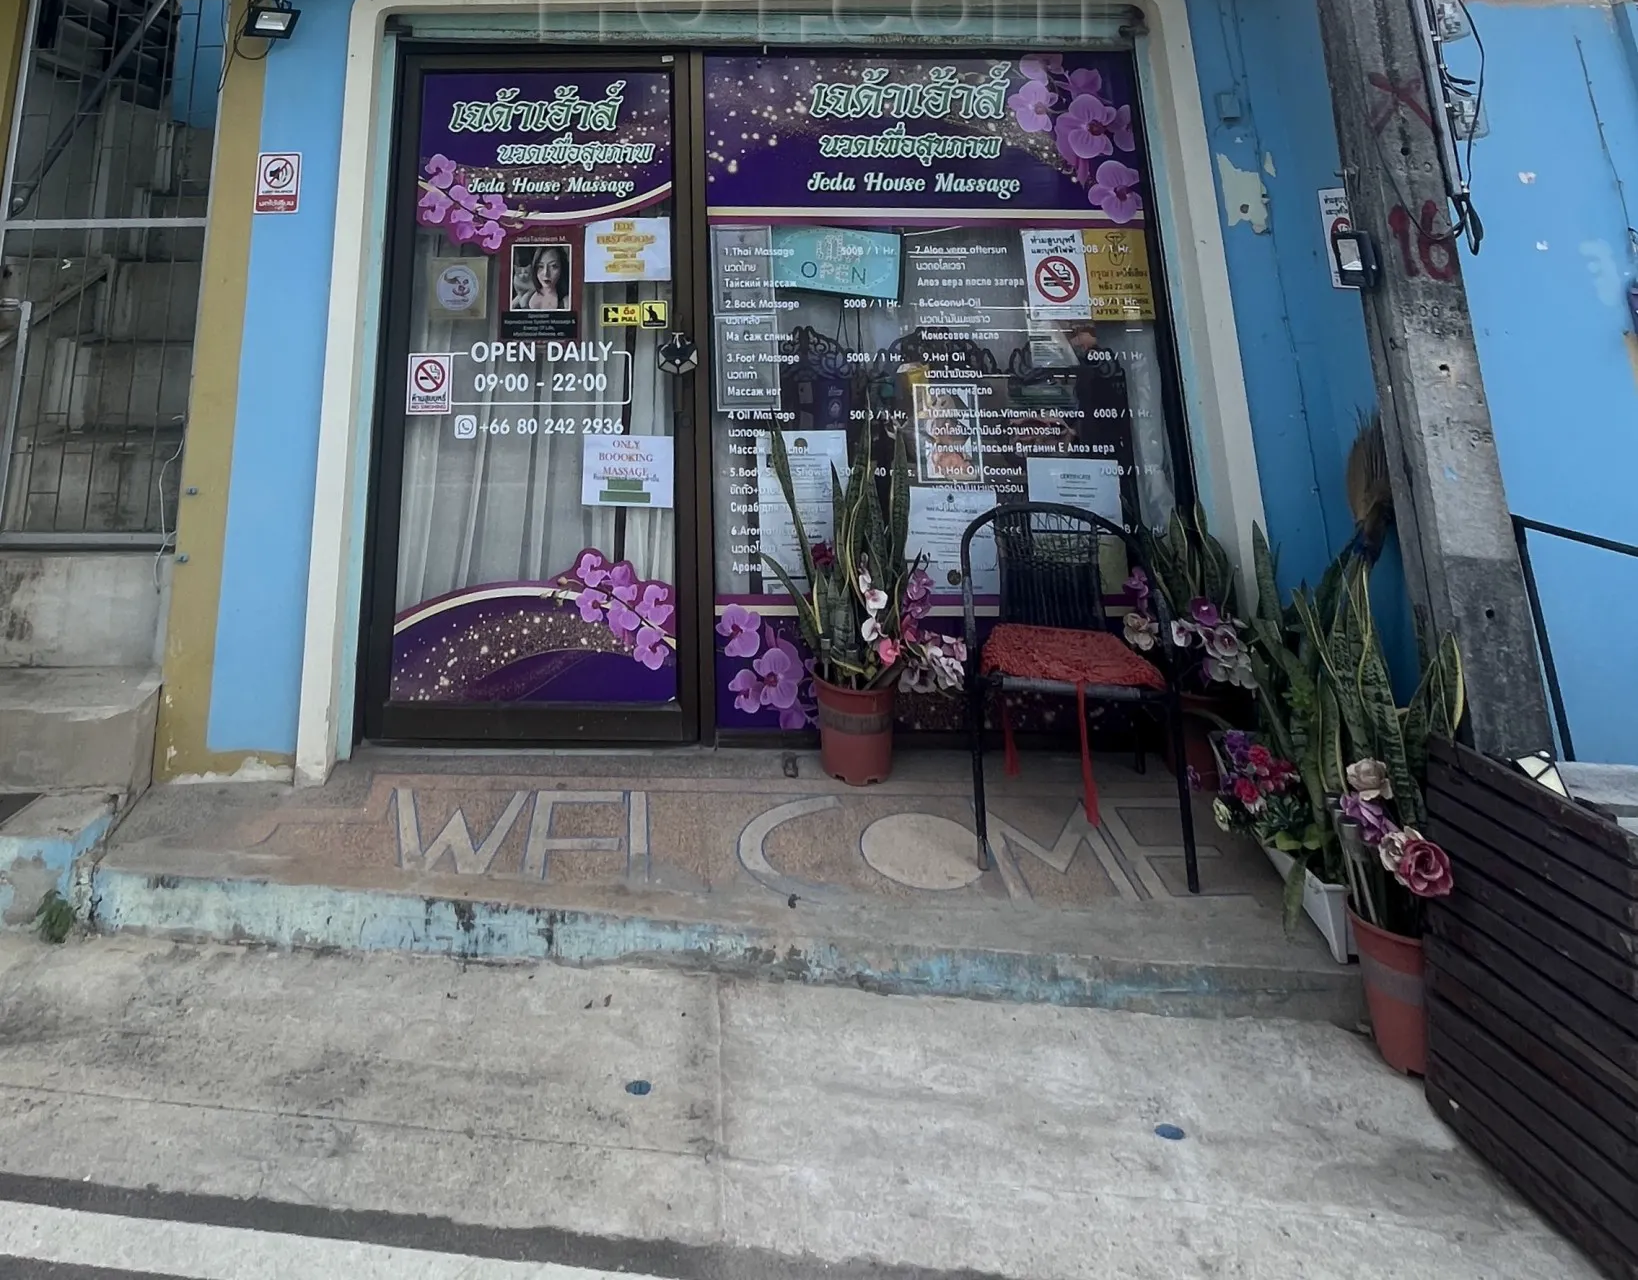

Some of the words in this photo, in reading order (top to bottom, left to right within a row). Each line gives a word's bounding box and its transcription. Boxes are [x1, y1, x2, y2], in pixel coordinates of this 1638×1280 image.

[818, 122, 1003, 167] นวดเพื่อสุขภาพ
[496, 133, 656, 171] นวดเพื่อสุขภาพ
[467, 176, 505, 194] Jeda
[512, 176, 561, 194] House
[567, 176, 634, 197] Massage
[807, 172, 856, 194] Jeda
[863, 172, 926, 193] House
[934, 172, 1020, 199] Massage
[1387, 199, 1458, 282] 16
[754, 247, 795, 258] Massage
[724, 261, 757, 272] นวดไทย
[801, 261, 866, 286] OPEN
[725, 277, 761, 288] Тайский
[763, 279, 798, 288] массаж
[965, 278, 992, 287] после
[994, 278, 1025, 288] загара
[759, 299, 800, 310] Massage
[886, 299, 902, 308] Hr.
[921, 330, 970, 340] Кокосовое
[972, 331, 1000, 340] масло
[471, 341, 536, 363] OPEN
[547, 341, 613, 363] DAILY
[922, 352, 949, 363] 9.Hot
[952, 351, 966, 362] Oil
[758, 353, 800, 365] Massage
[890, 352, 905, 362] Hr.
[727, 386, 764, 397] Массаж
[1000, 408, 1038, 418] Vitamin
[1049, 408, 1085, 418] Alovera
[479, 418, 510, 435] +66
[516, 418, 538, 435] 80
[544, 418, 576, 435] 242
[581, 418, 624, 435] 2936
[612, 440, 641, 450] ONLY
[729, 444, 765, 454] Массаж
[981, 443, 1013, 453] лосьон
[1015, 442, 1056, 453] Витамин
[1067, 442, 1090, 452] Алоэ
[1093, 444, 1115, 455] вера
[598, 452, 654, 463] BOOOKING
[602, 466, 648, 477] MASSAGE
[983, 465, 1023, 476] Coconut
[730, 501, 759, 516] Скраб
